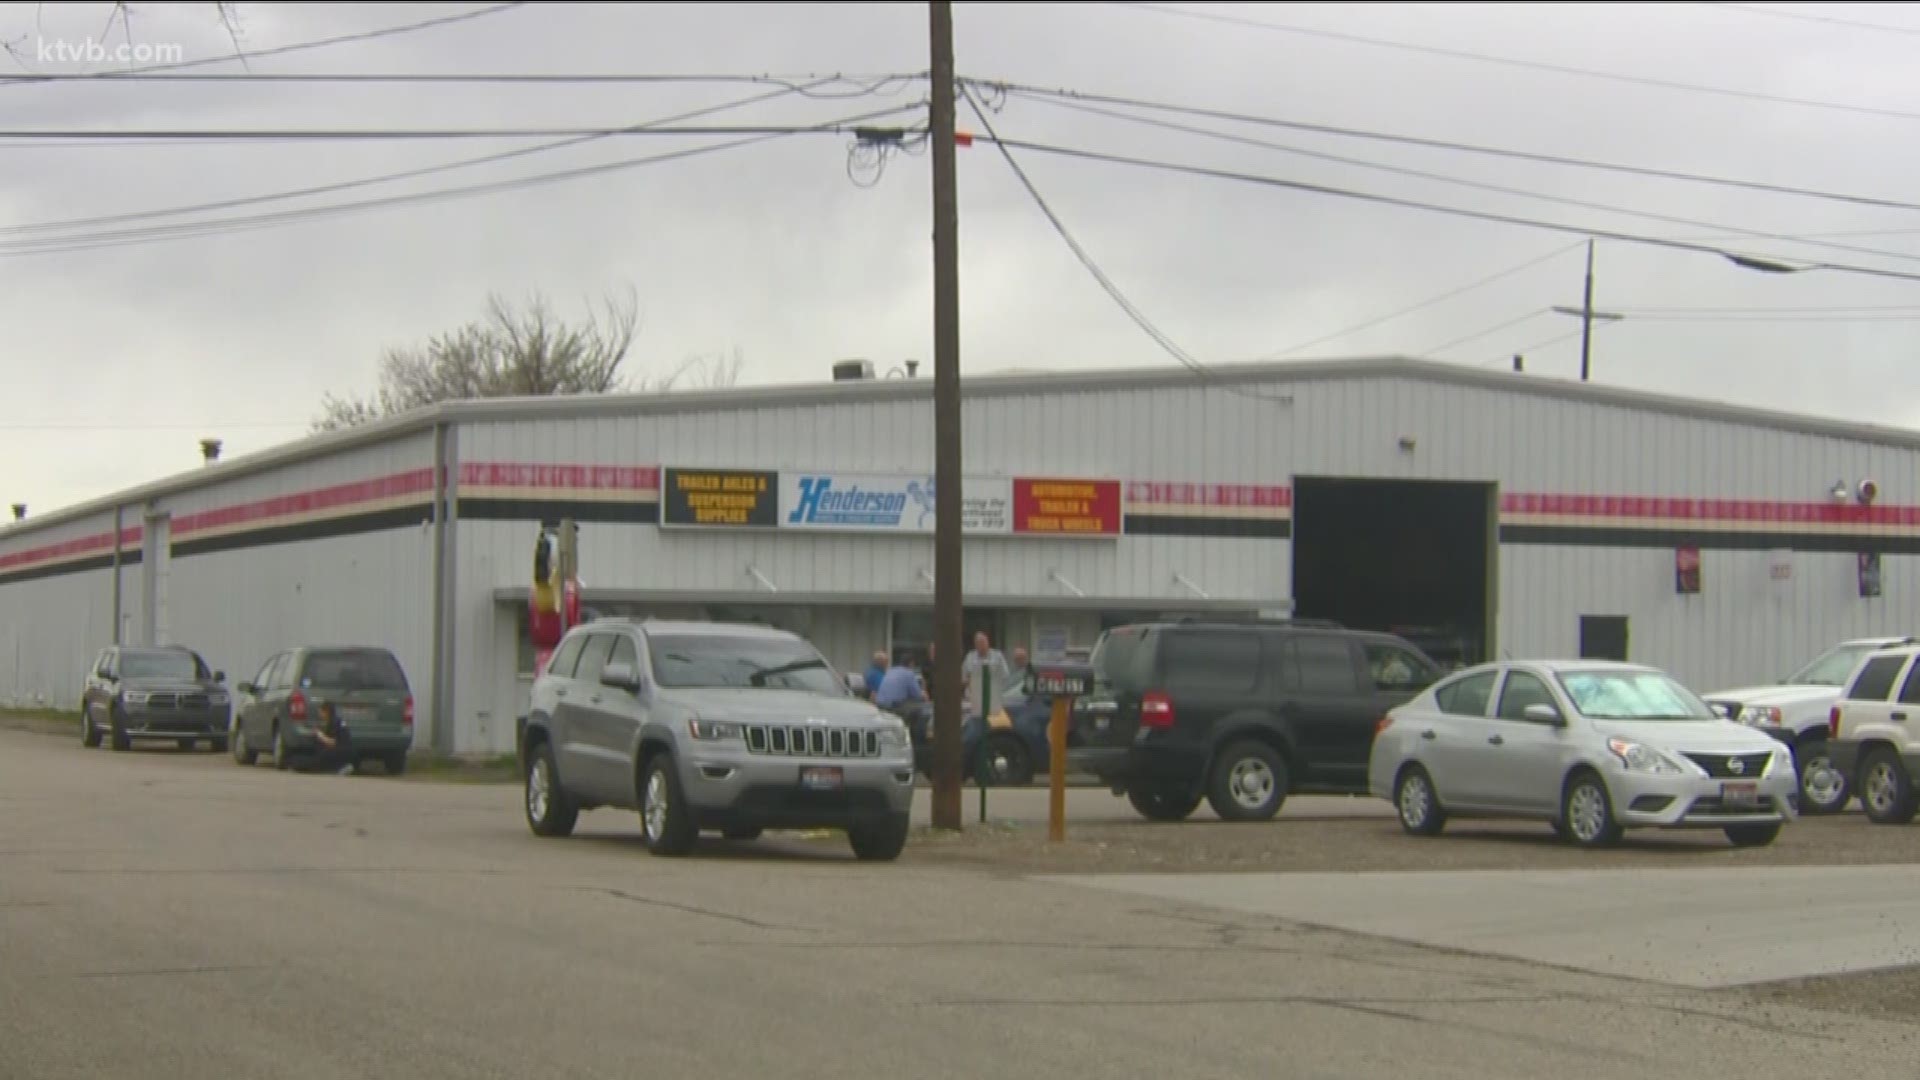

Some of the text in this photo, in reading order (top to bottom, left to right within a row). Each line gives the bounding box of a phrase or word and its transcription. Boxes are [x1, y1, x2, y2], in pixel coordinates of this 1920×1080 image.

[677, 474, 721, 490] TRAILER
[687, 493, 756, 508] SUSPENSION
[788, 476, 907, 524] Henderson
[1040, 499, 1080, 514] TRAILER
[695, 507, 748, 523] SUPPLIES
[1027, 516, 1103, 531] TRUCK WHEELS
